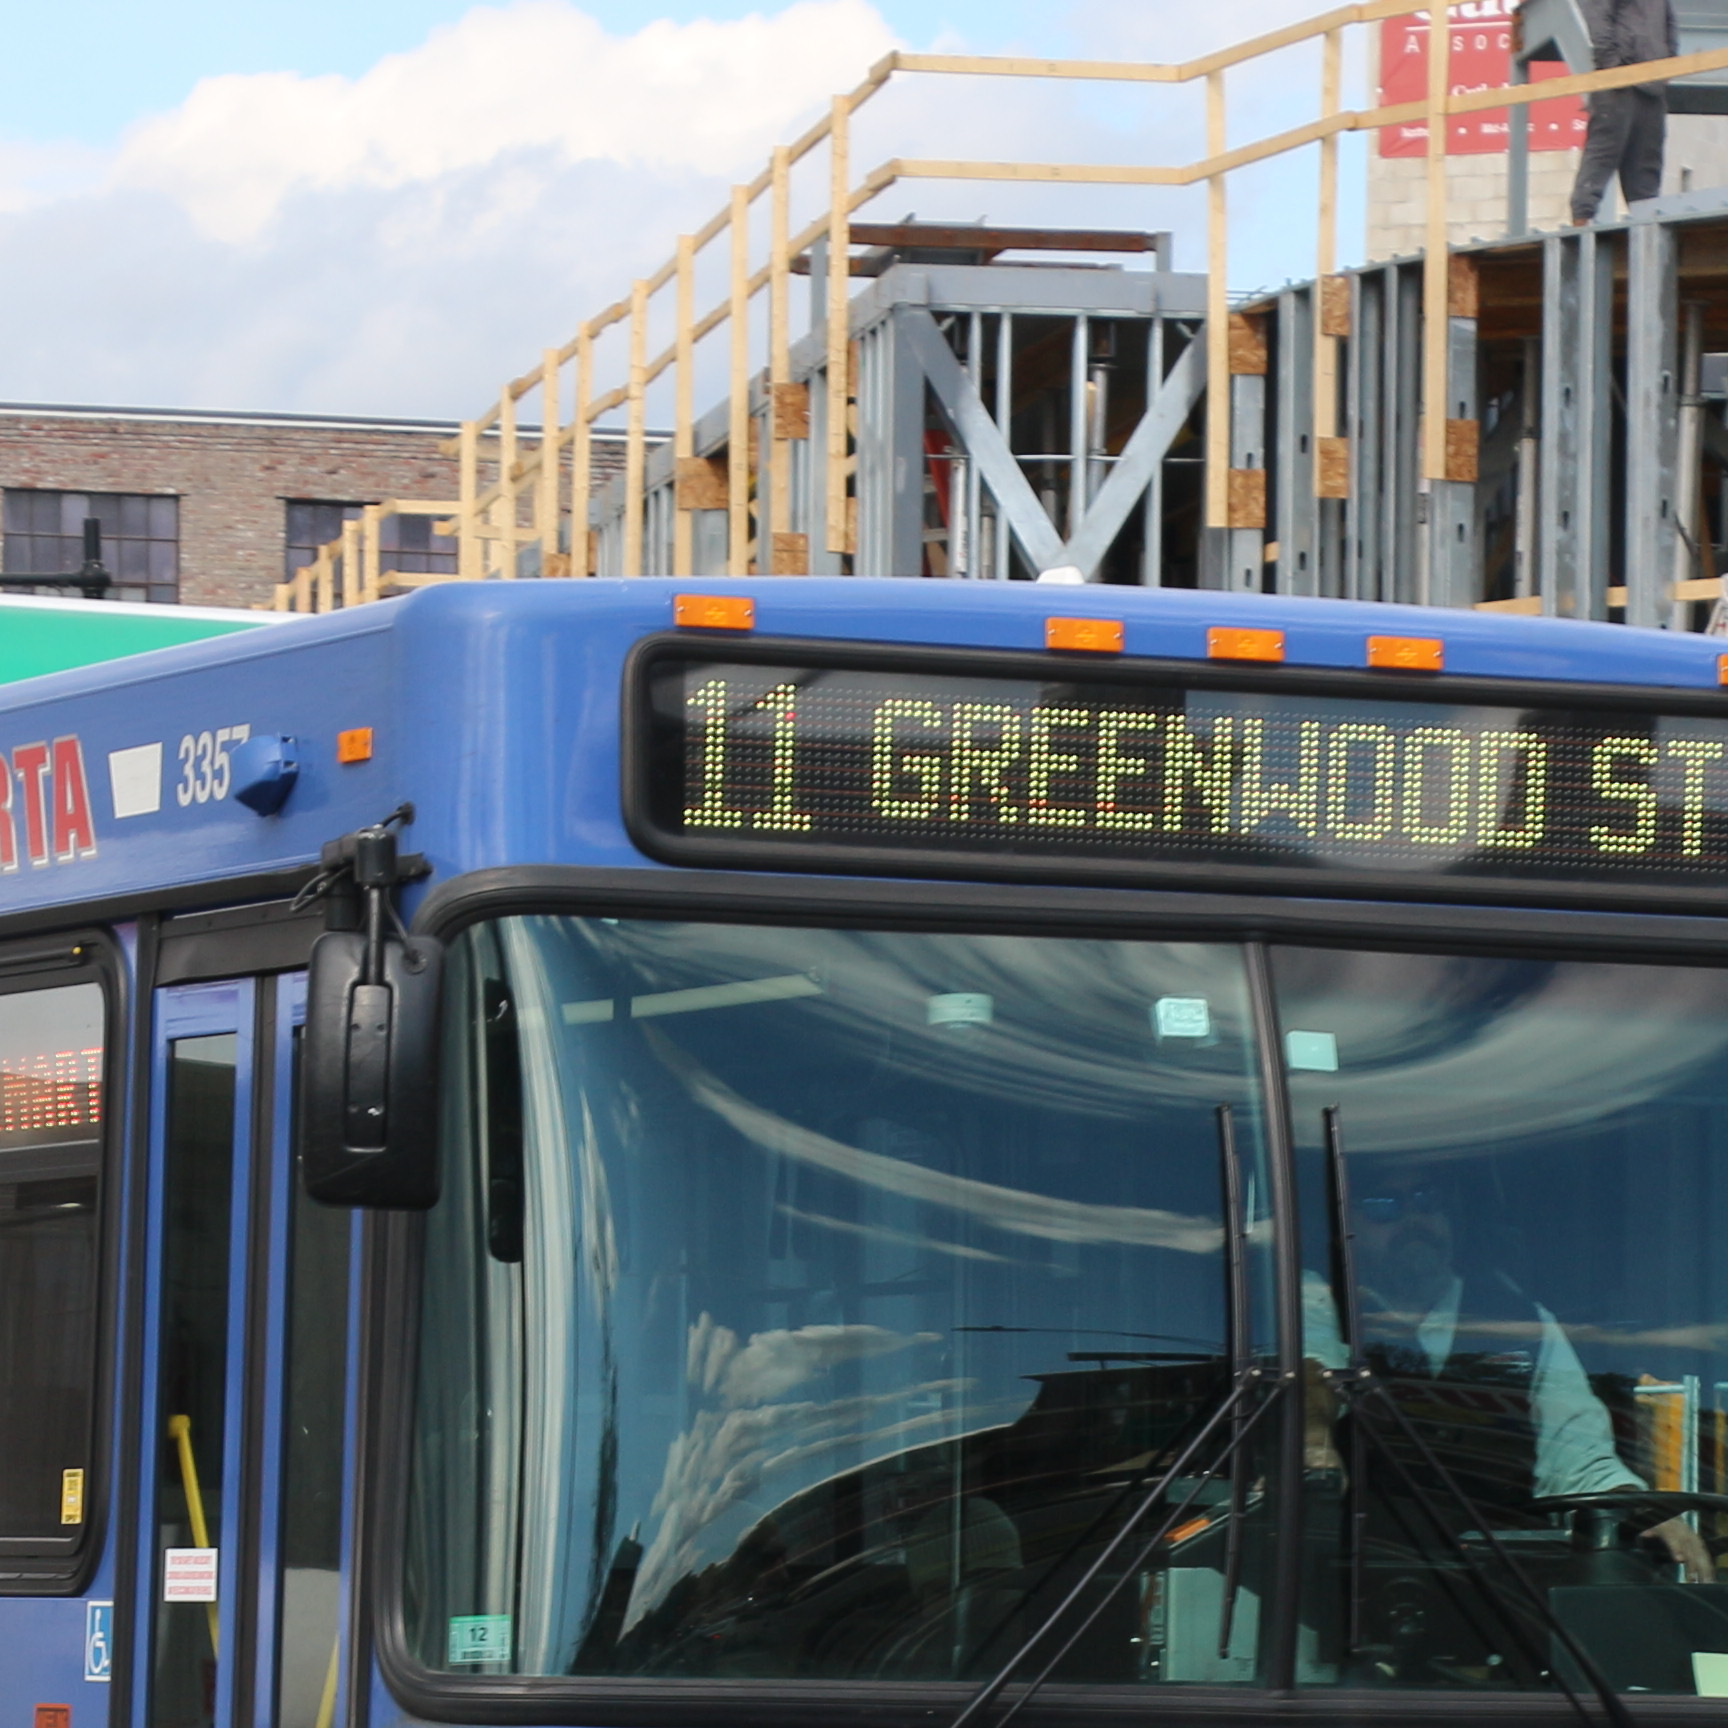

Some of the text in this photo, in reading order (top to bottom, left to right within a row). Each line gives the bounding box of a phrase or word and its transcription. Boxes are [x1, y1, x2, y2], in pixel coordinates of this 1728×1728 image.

[683, 678, 1724, 859] 11 GREENWOOD ST
[469, 1626, 488, 1643] 12
